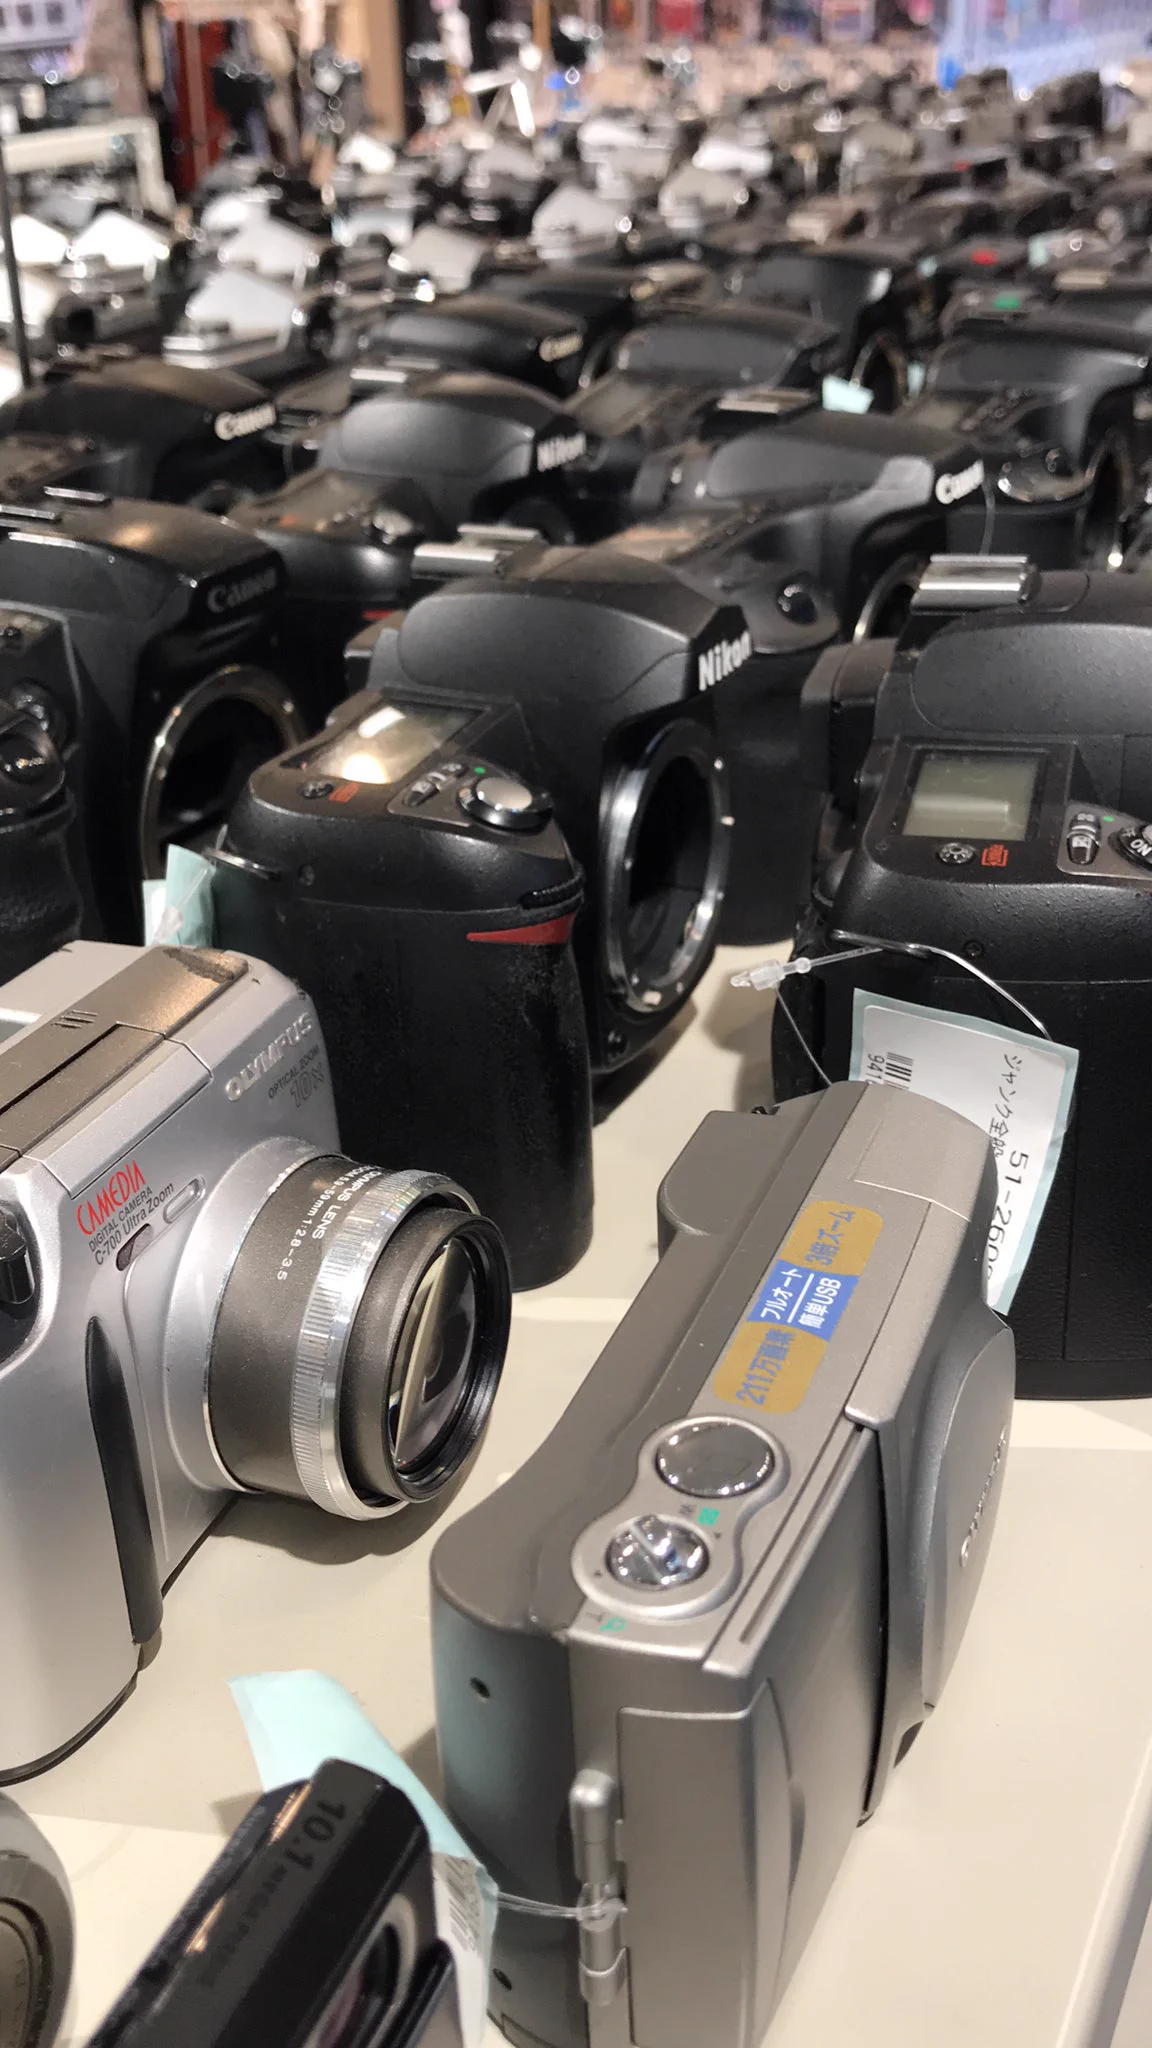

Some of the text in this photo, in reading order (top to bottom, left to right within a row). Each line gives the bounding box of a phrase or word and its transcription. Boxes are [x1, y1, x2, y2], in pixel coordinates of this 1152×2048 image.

[698, 630, 752, 692] Nikon
[225, 1011, 313, 1102] OLYMPUS
[267, 1066, 300, 1101] OPTICAL
[864, 1052, 886, 1084] 941
[75, 1159, 147, 1236] CAMEDIA
[88, 1186, 154, 1253] DIGITAL CAMERA
[94, 1182, 176, 1266] C-700 Ultra Zoom
[311, 1204, 342, 1240] LENS
[804, 1208, 857, 1267] 3倍ズーム
[759, 1267, 803, 1321] フルオート
[797, 1276, 842, 1329] 簡単USB
[283, 1799, 347, 1872] 10.1
